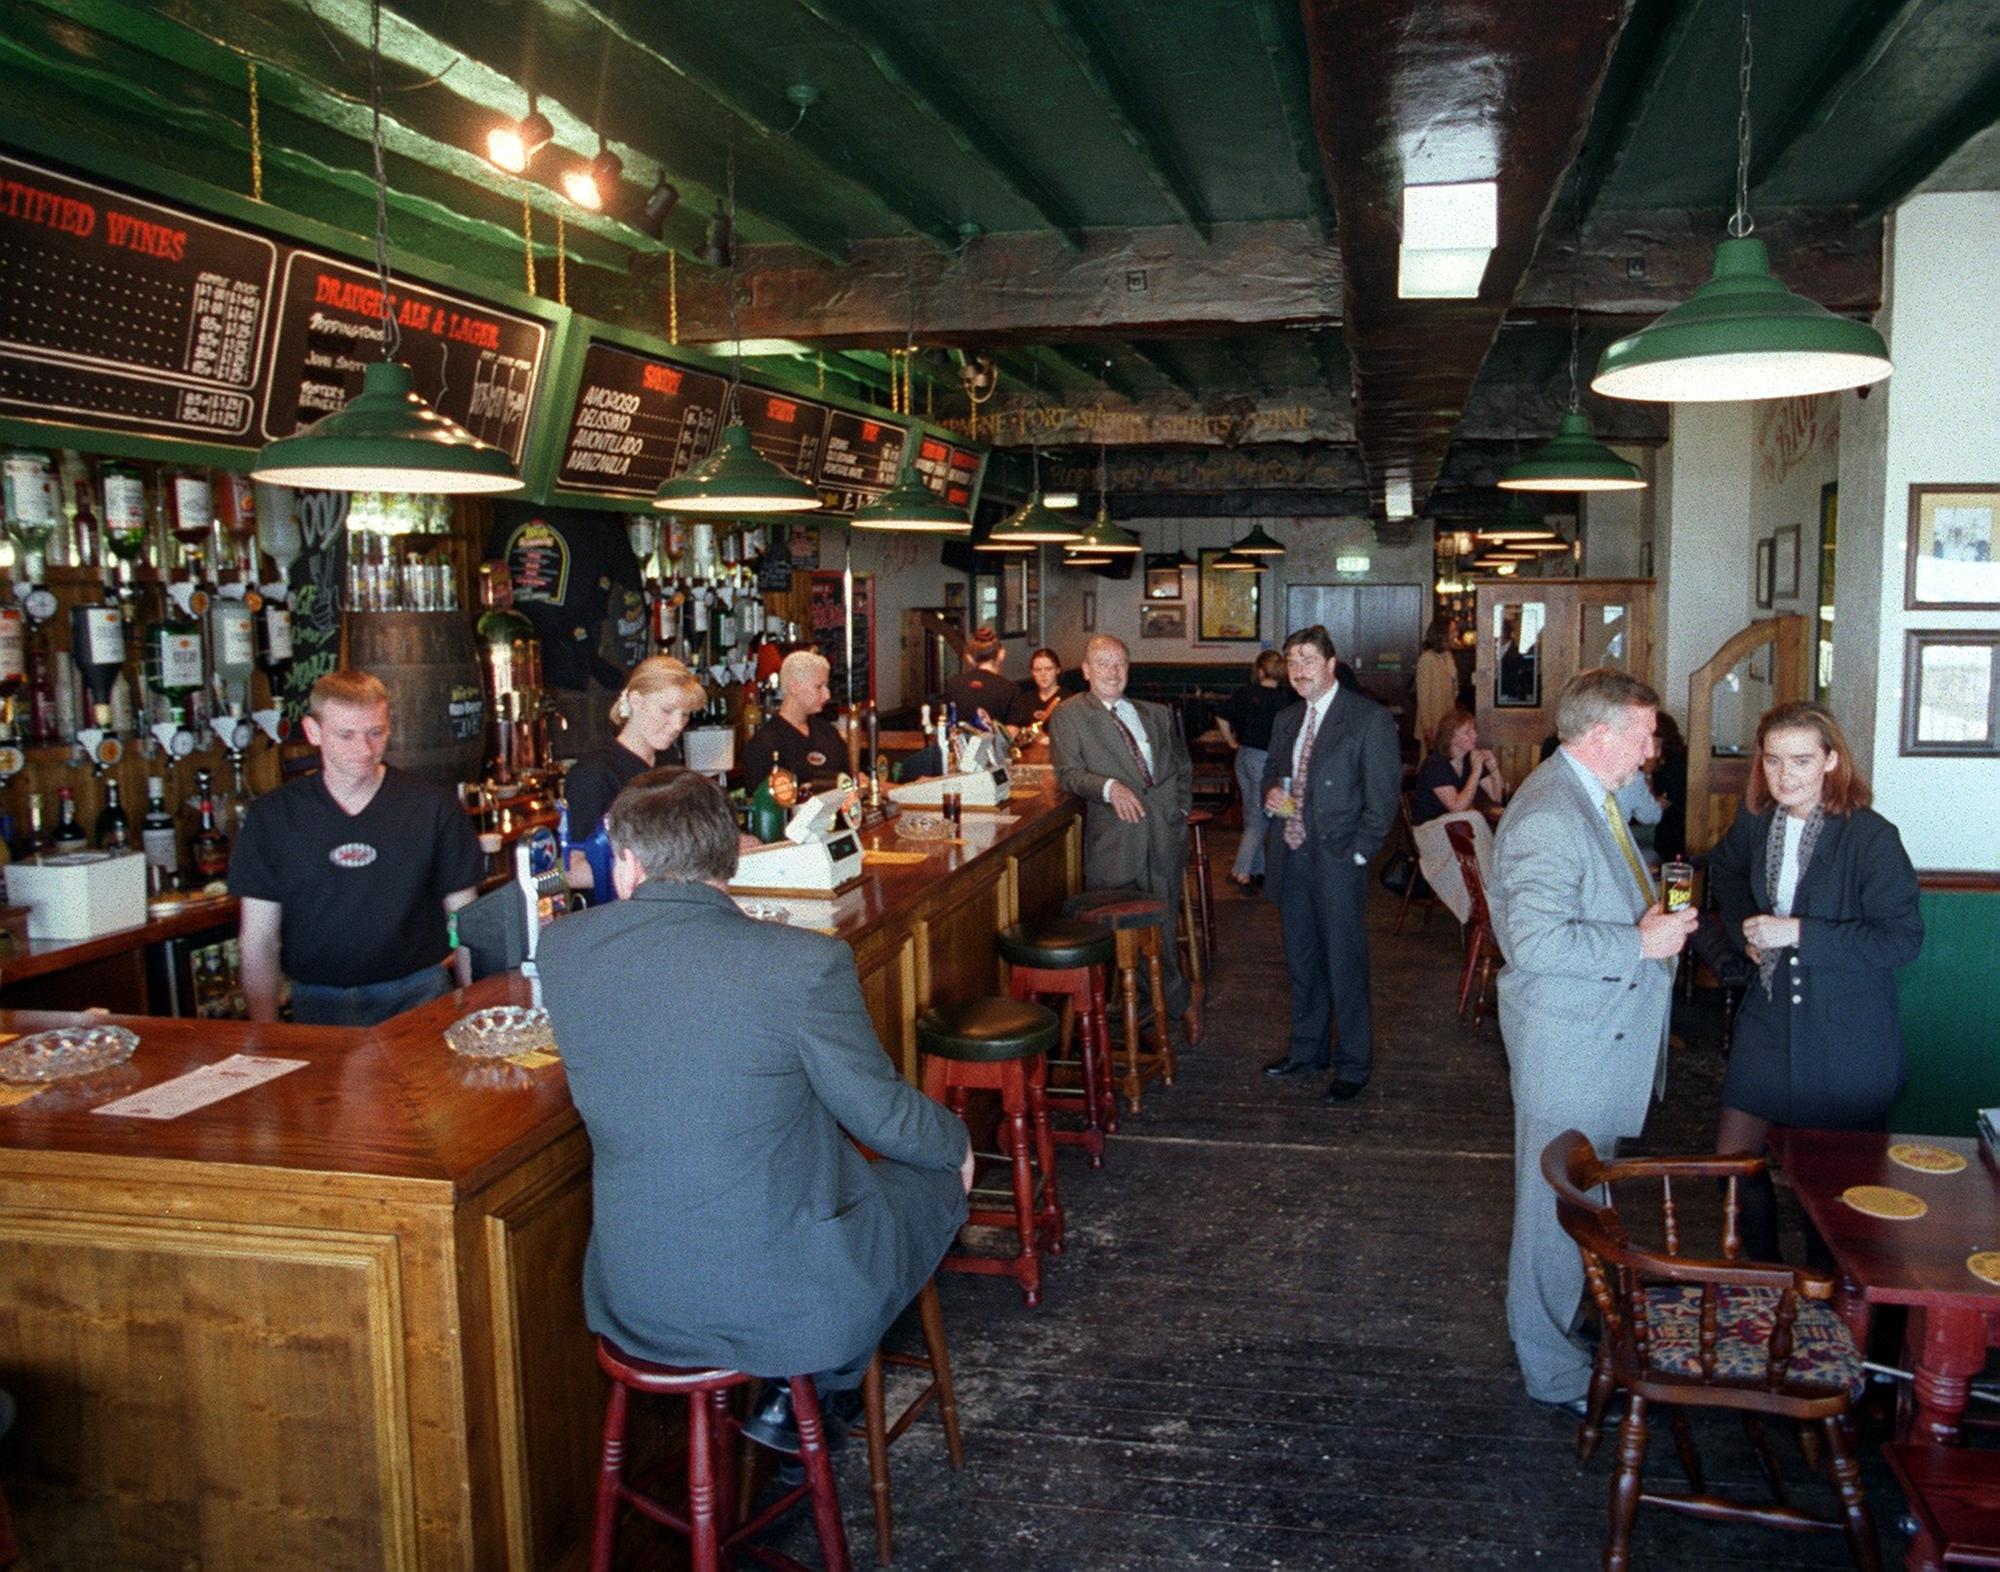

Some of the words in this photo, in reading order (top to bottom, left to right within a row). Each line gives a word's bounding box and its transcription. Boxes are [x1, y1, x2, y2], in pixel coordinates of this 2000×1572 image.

[107, 211, 187, 261] WINES
[398, 300, 432, 329] ALE
[432, 309, 445, 335] &
[449, 313, 499, 350] LAGER
[583, 387, 640, 413] AMOROSO
[572, 430, 643, 455] AMONTILLADO
[567, 452, 631, 475] MANZANILLA
